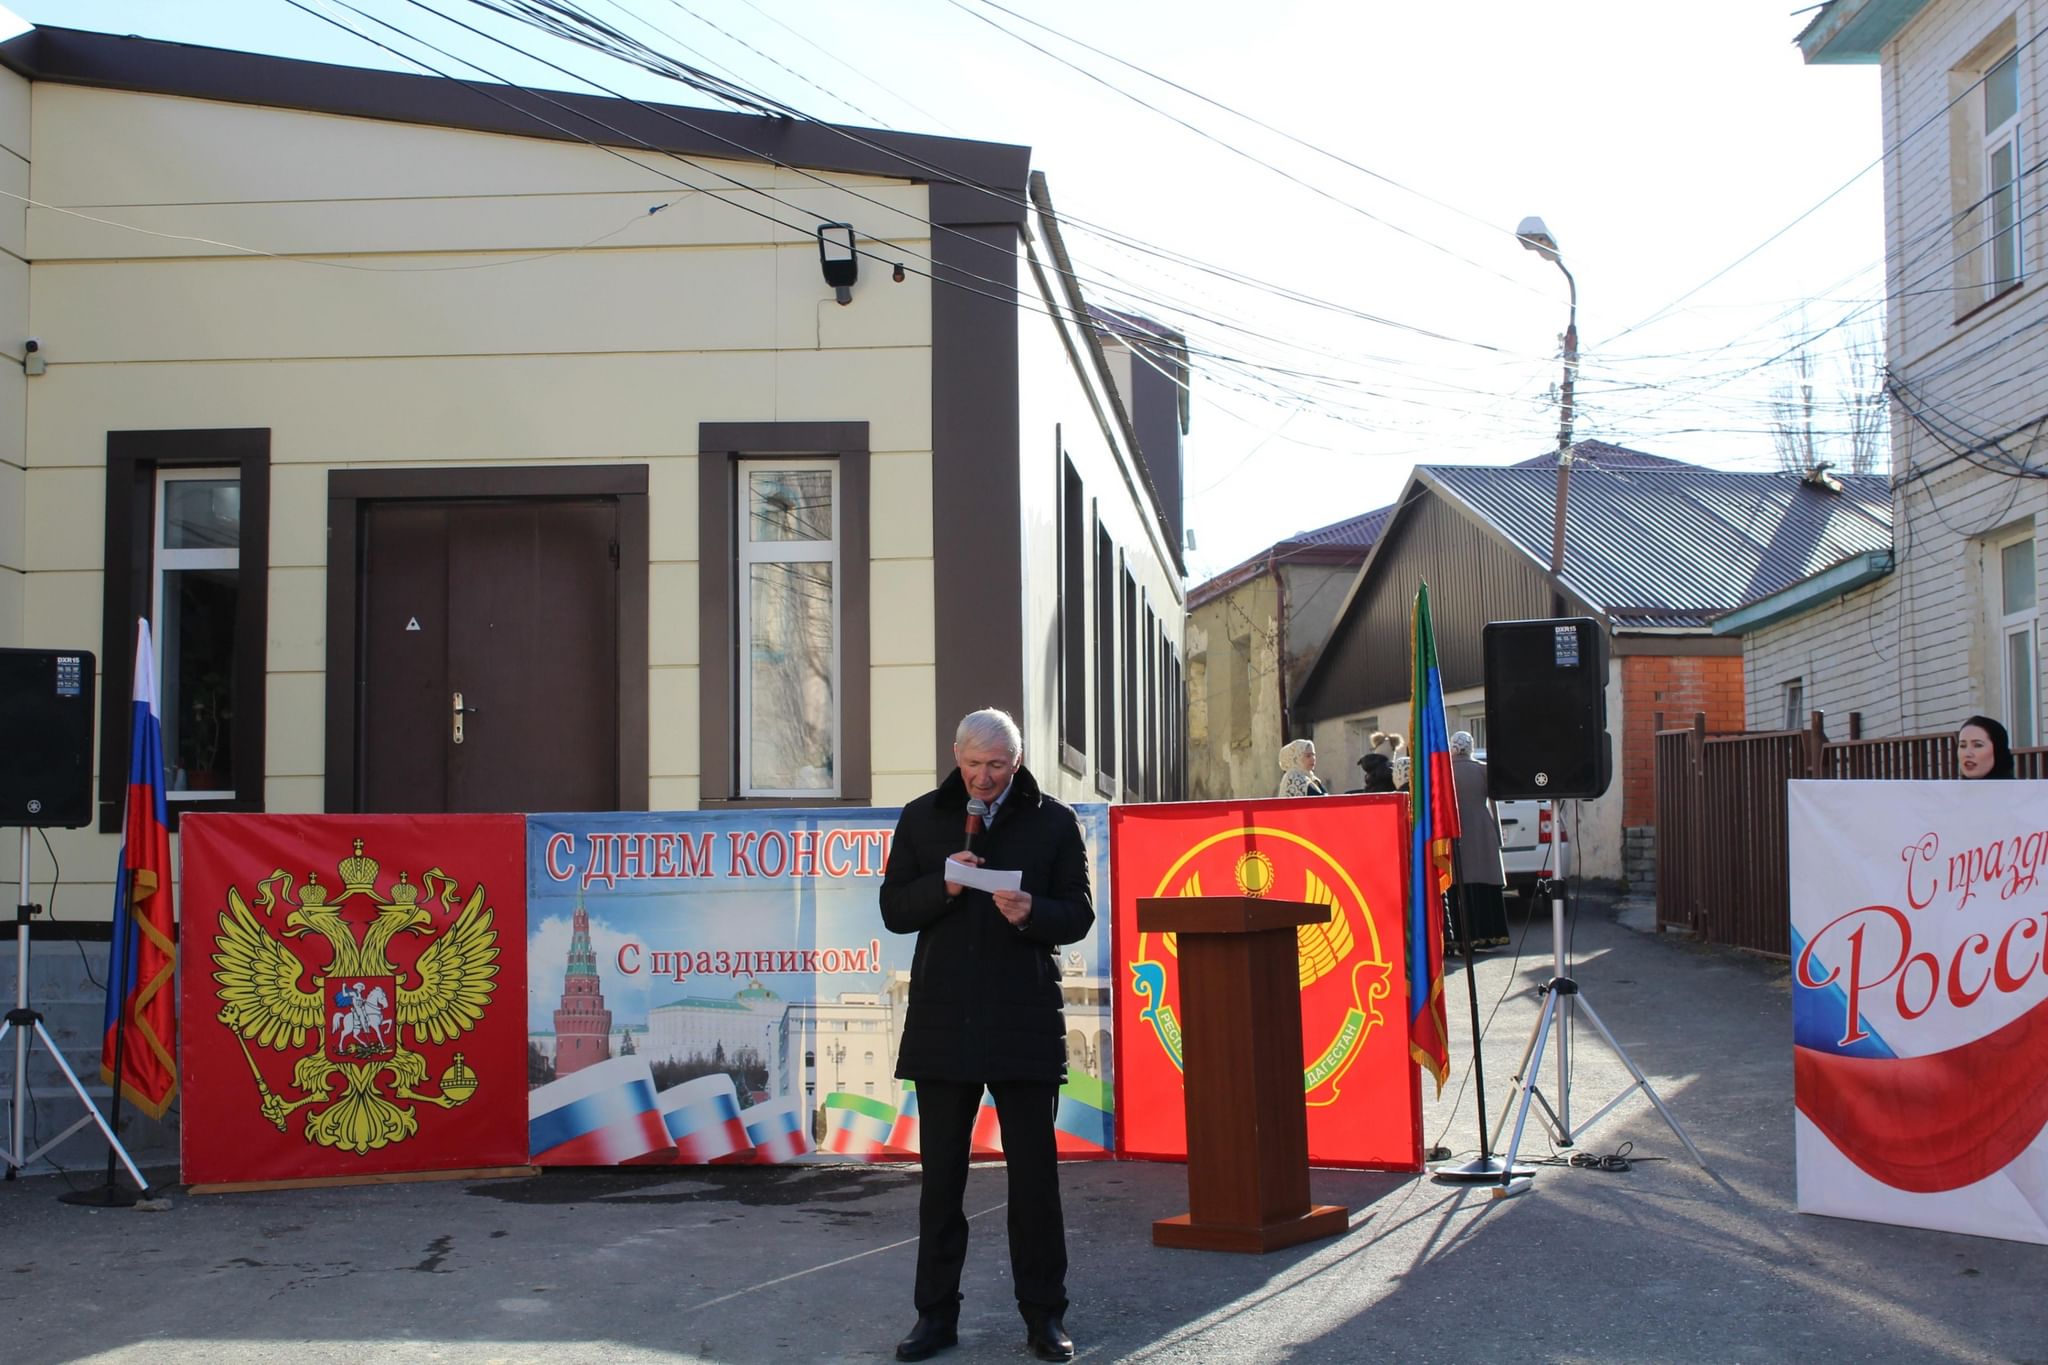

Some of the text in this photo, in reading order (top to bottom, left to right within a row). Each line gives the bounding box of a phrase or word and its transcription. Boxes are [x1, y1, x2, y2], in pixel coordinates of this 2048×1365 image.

[546, 833, 574, 880] С
[581, 832, 716, 889] ДНЕМ
[1902, 832, 1939, 910] С
[617, 938, 881, 982] С праздником!
[1306, 1023, 1358, 1086] ДАГЕСТАН
